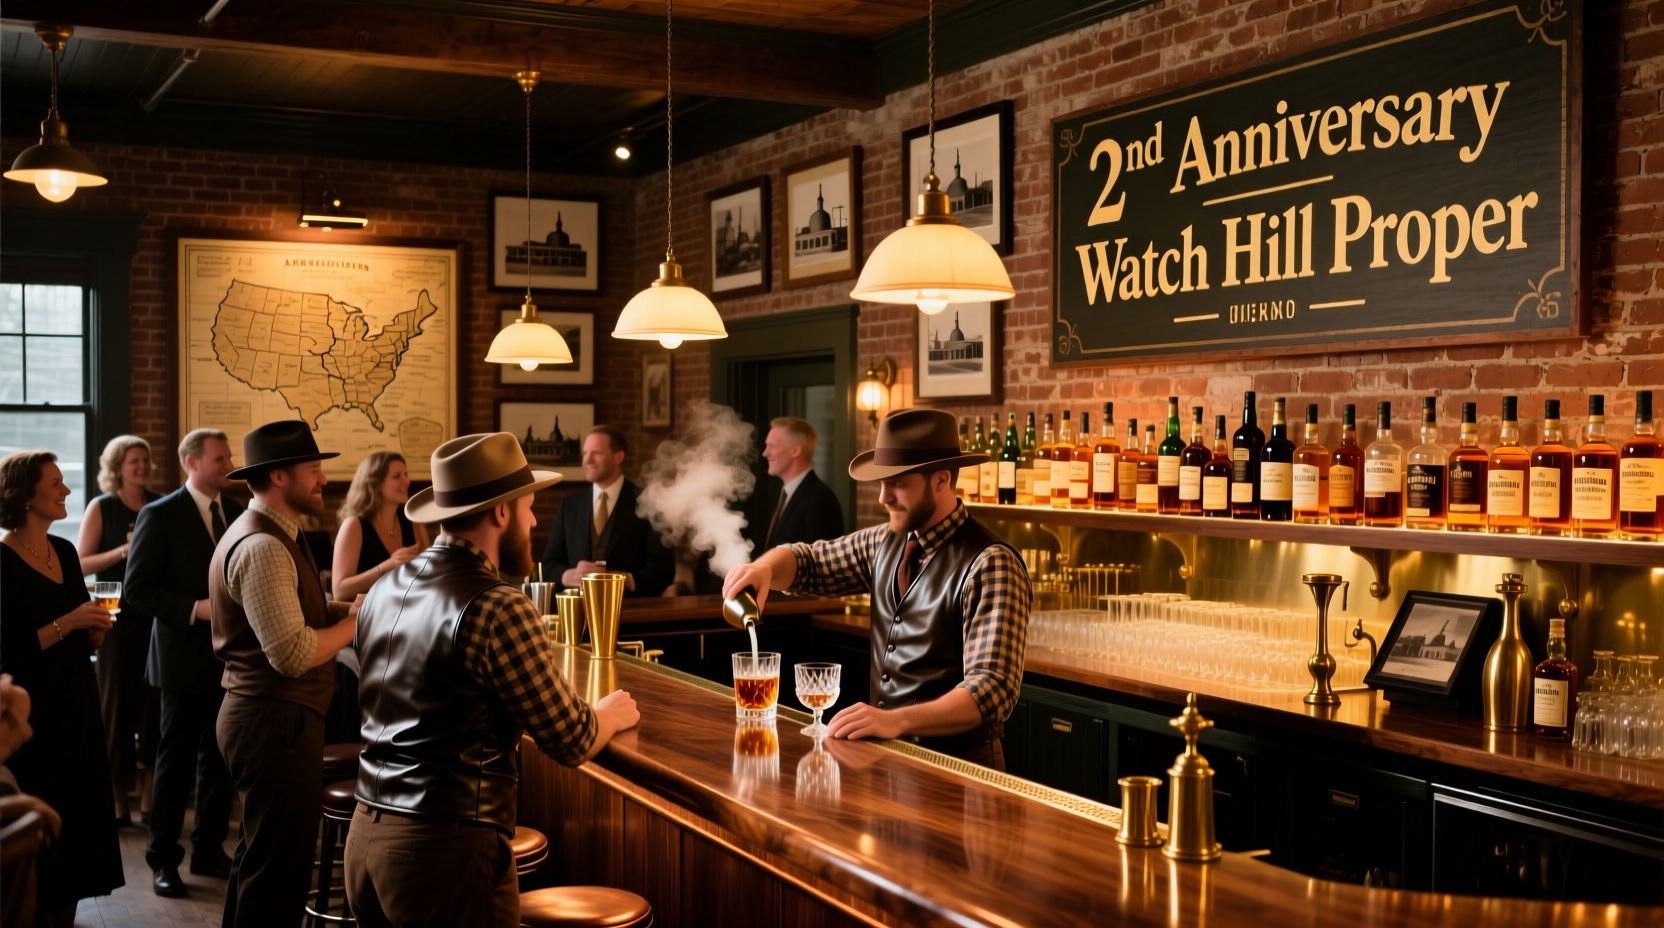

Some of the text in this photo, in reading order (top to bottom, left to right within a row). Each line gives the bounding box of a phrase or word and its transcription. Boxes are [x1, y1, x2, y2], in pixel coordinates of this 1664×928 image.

[1088, 81, 1511, 227] 2nd Anniversary
[1075, 191, 1539, 306] Watch Hill Proper
